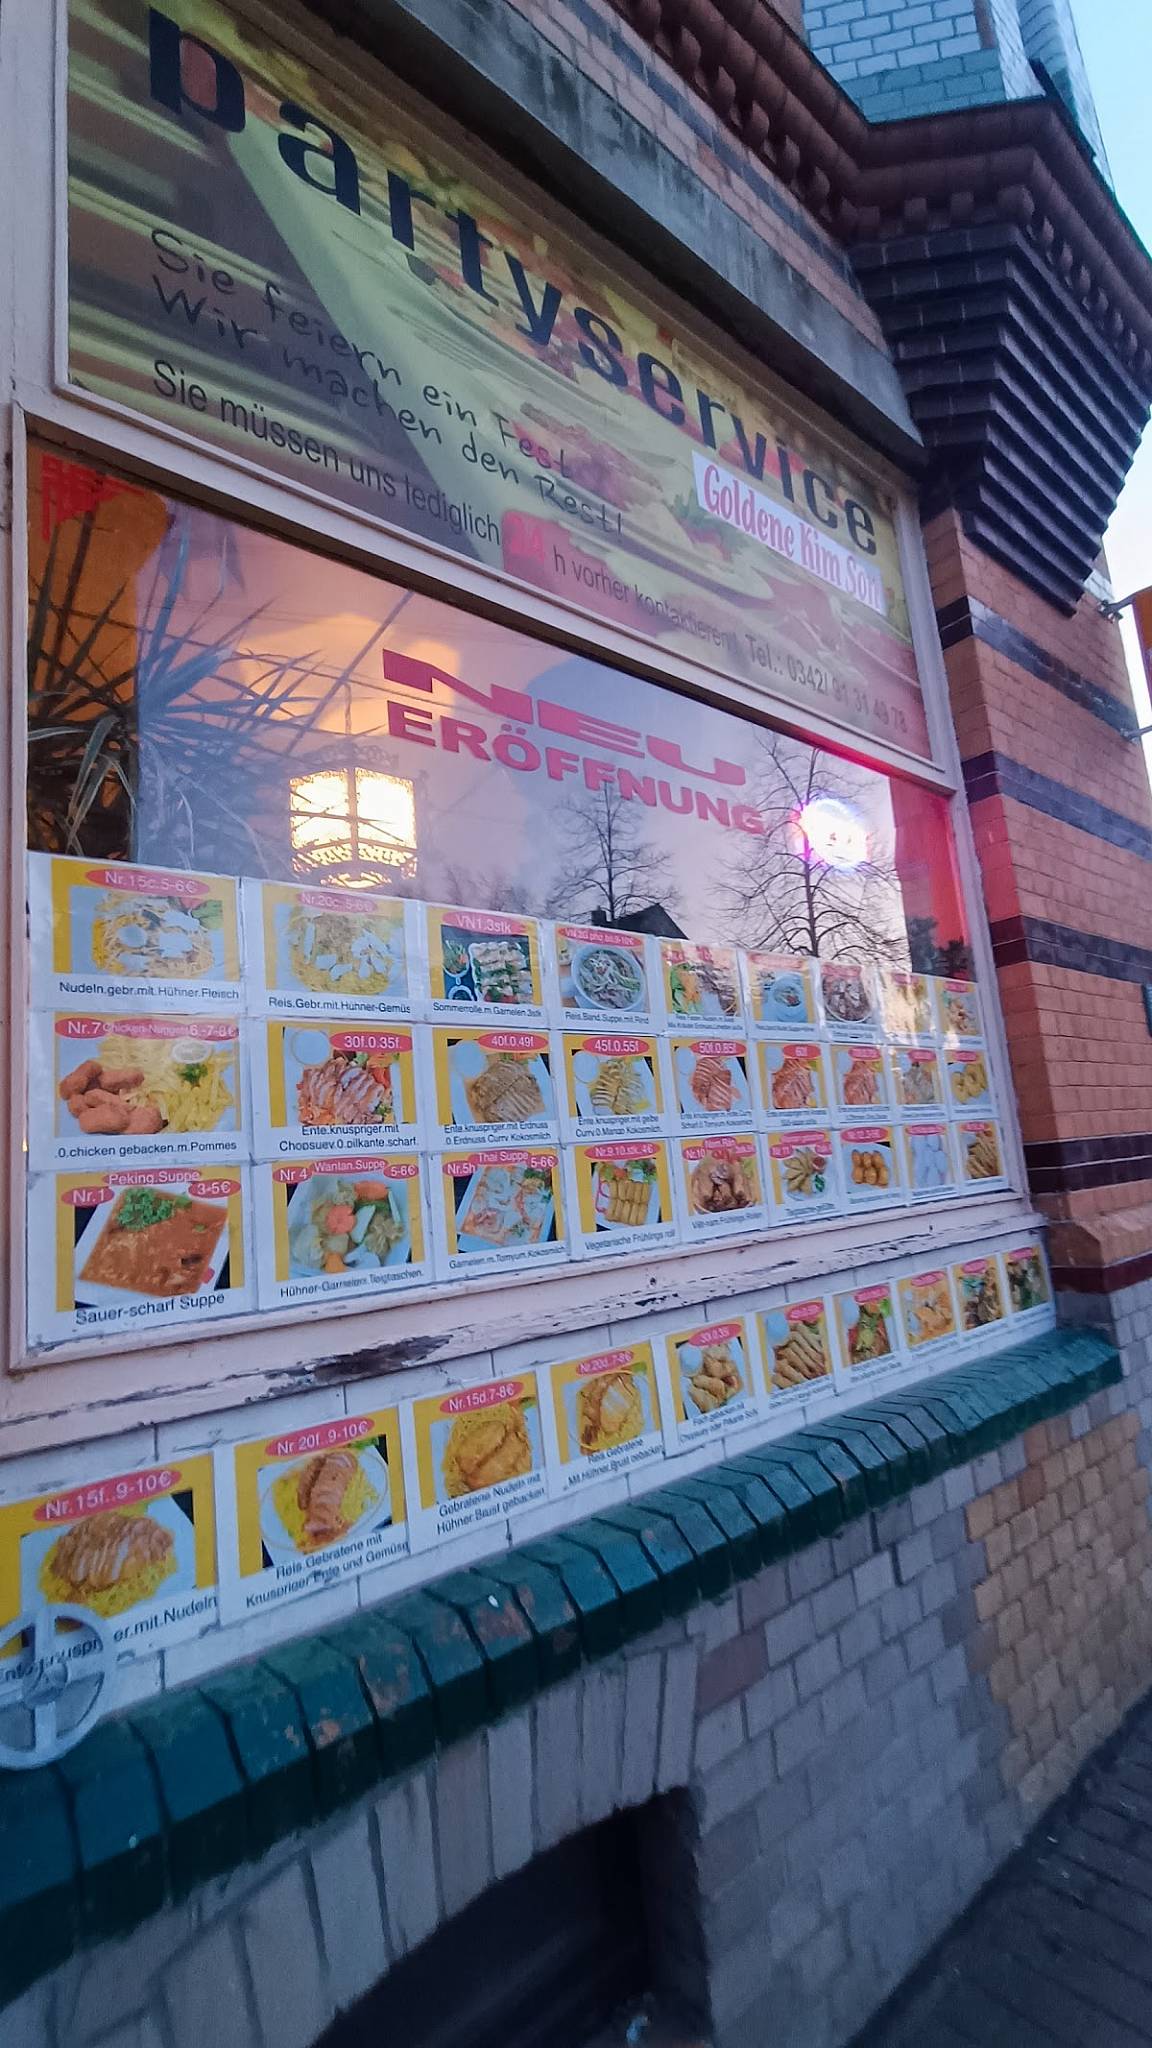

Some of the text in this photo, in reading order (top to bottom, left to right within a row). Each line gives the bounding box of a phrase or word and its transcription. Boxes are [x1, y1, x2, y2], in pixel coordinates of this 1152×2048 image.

[151, 229, 571, 480] Sie feiern ein Fest
[153, 275, 623, 543] Wir machen den Rest!
[153, 360, 208, 414] Sie
[221, 396, 341, 472] müssen
[350, 459, 397, 499] uns
[405, 475, 502, 548] lediglich
[572, 560, 630, 602] vorher
[703, 463, 795, 559] Goldene
[382, 648, 747, 786] NEU
[387, 699, 766, 836] ERÖFFNUNG
[178, 1292, 225, 1311] Suppe
